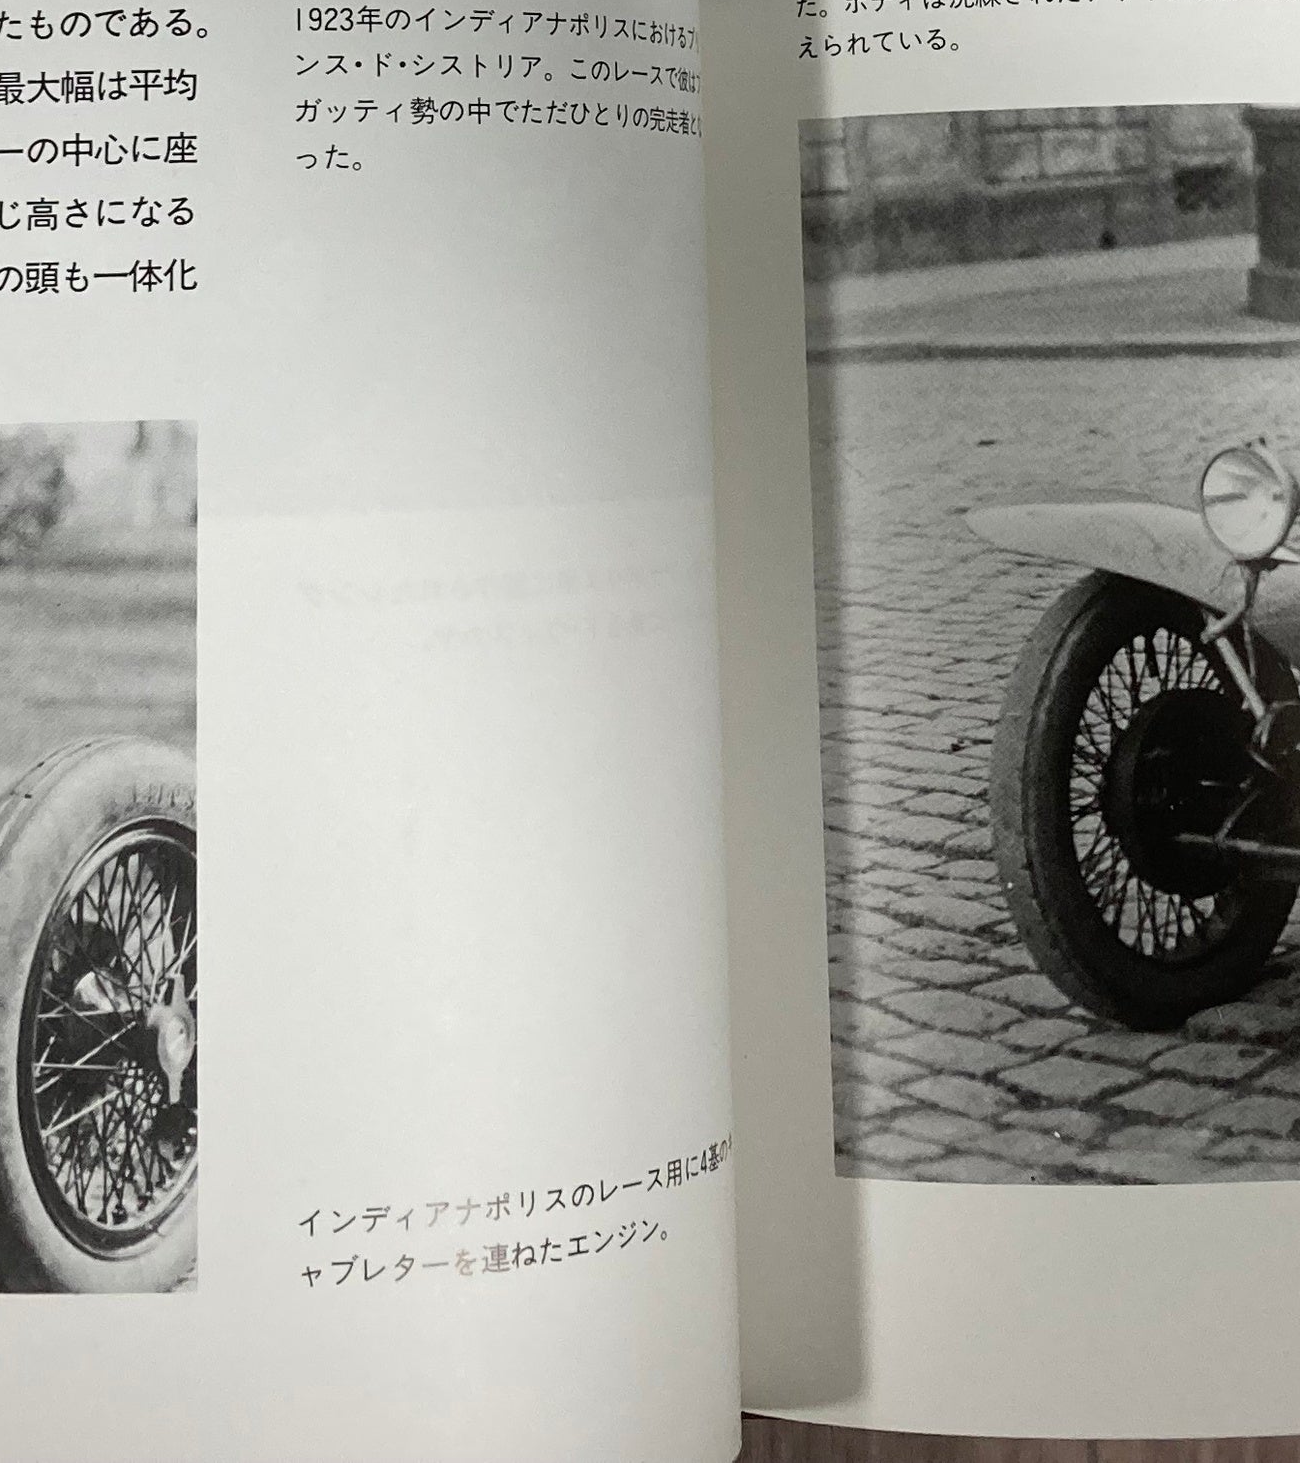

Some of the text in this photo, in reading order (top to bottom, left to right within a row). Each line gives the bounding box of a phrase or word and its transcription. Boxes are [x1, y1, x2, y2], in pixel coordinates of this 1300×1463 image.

[799, 29, 959, 58] えられている。
[296, 96, 701, 138] ガッティ勢の中でただひとりの完走者と
[296, 144, 363, 171] った。
[302, 1220, 667, 1287] ャブレターを連ねたエンジン。
